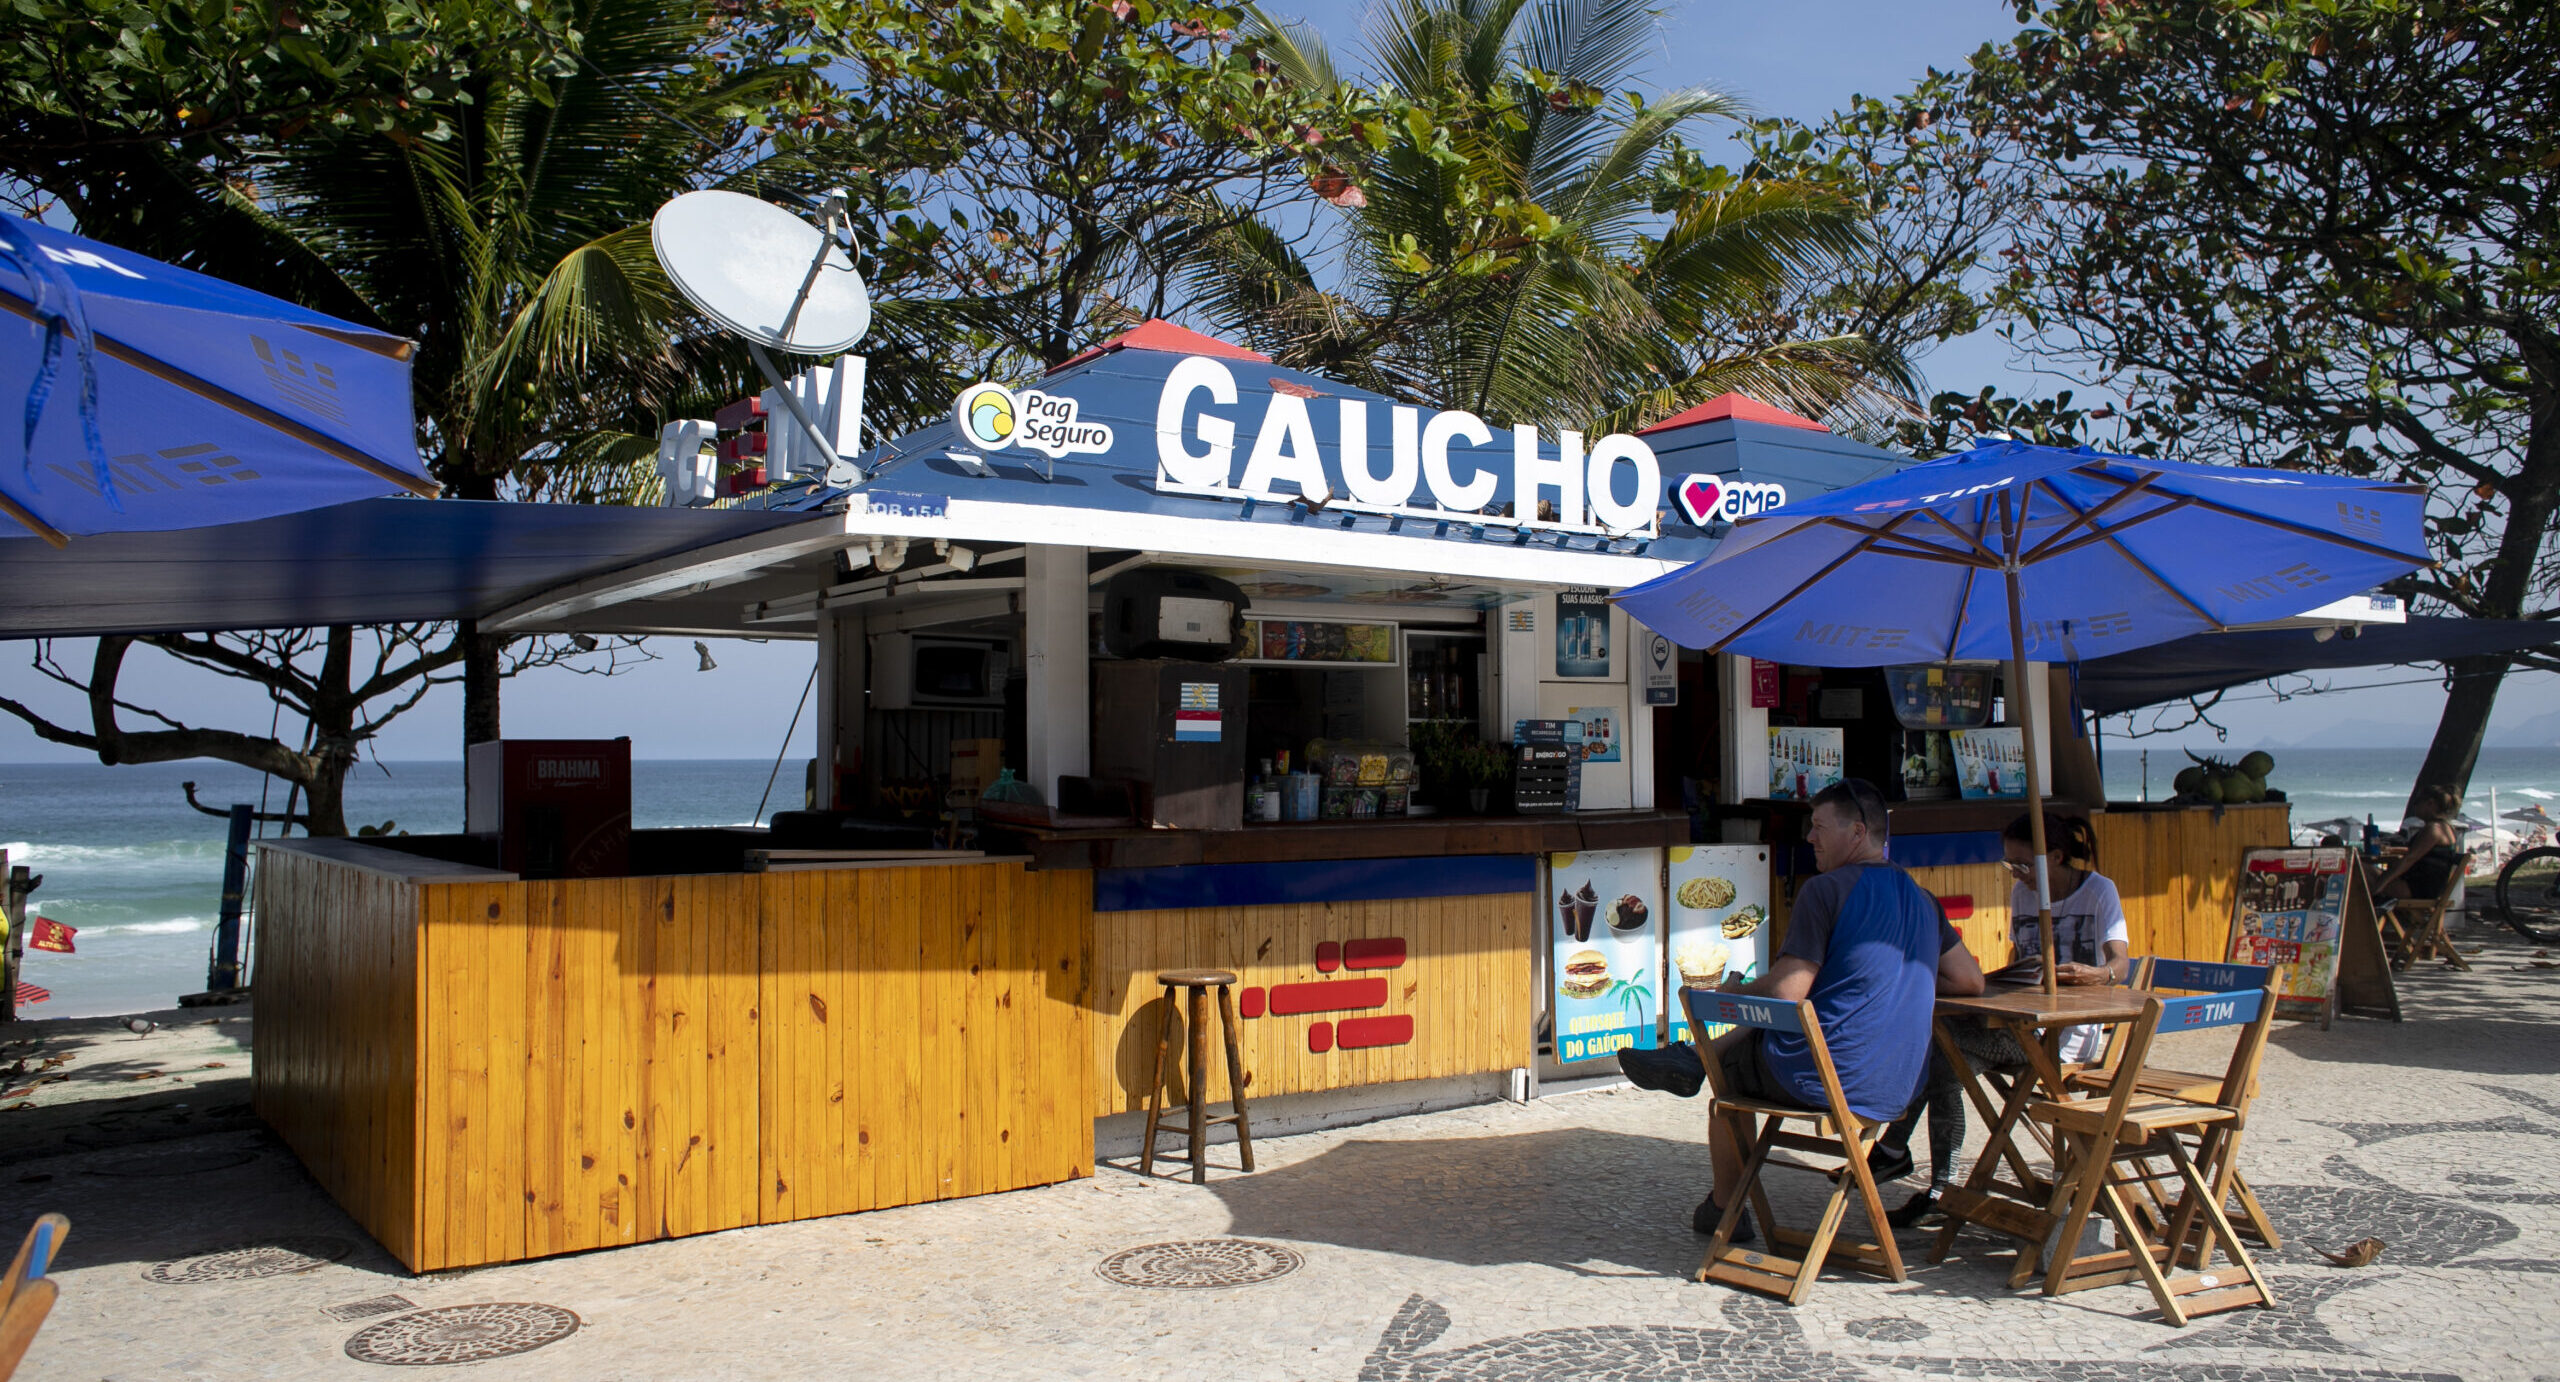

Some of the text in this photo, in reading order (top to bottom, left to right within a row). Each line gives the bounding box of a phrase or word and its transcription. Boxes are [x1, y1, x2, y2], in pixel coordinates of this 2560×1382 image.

[1026, 395, 1072, 424] Pag
[1023, 418, 1107, 449] Seguro
[1155, 354, 1663, 531] GAUCHO
[1919, 476, 2016, 503] TIM
[1562, 594, 1578, 604] SUAS
[537, 758, 601, 779] BRAHMA
[2204, 967, 2236, 988] TIM
[1569, 1011, 1626, 1035] QUIOSQUE
[1737, 1003, 1773, 1024] TIM
[2205, 1000, 2236, 1022] TIM
[1566, 1032, 1634, 1059] DO GAÚCHO
